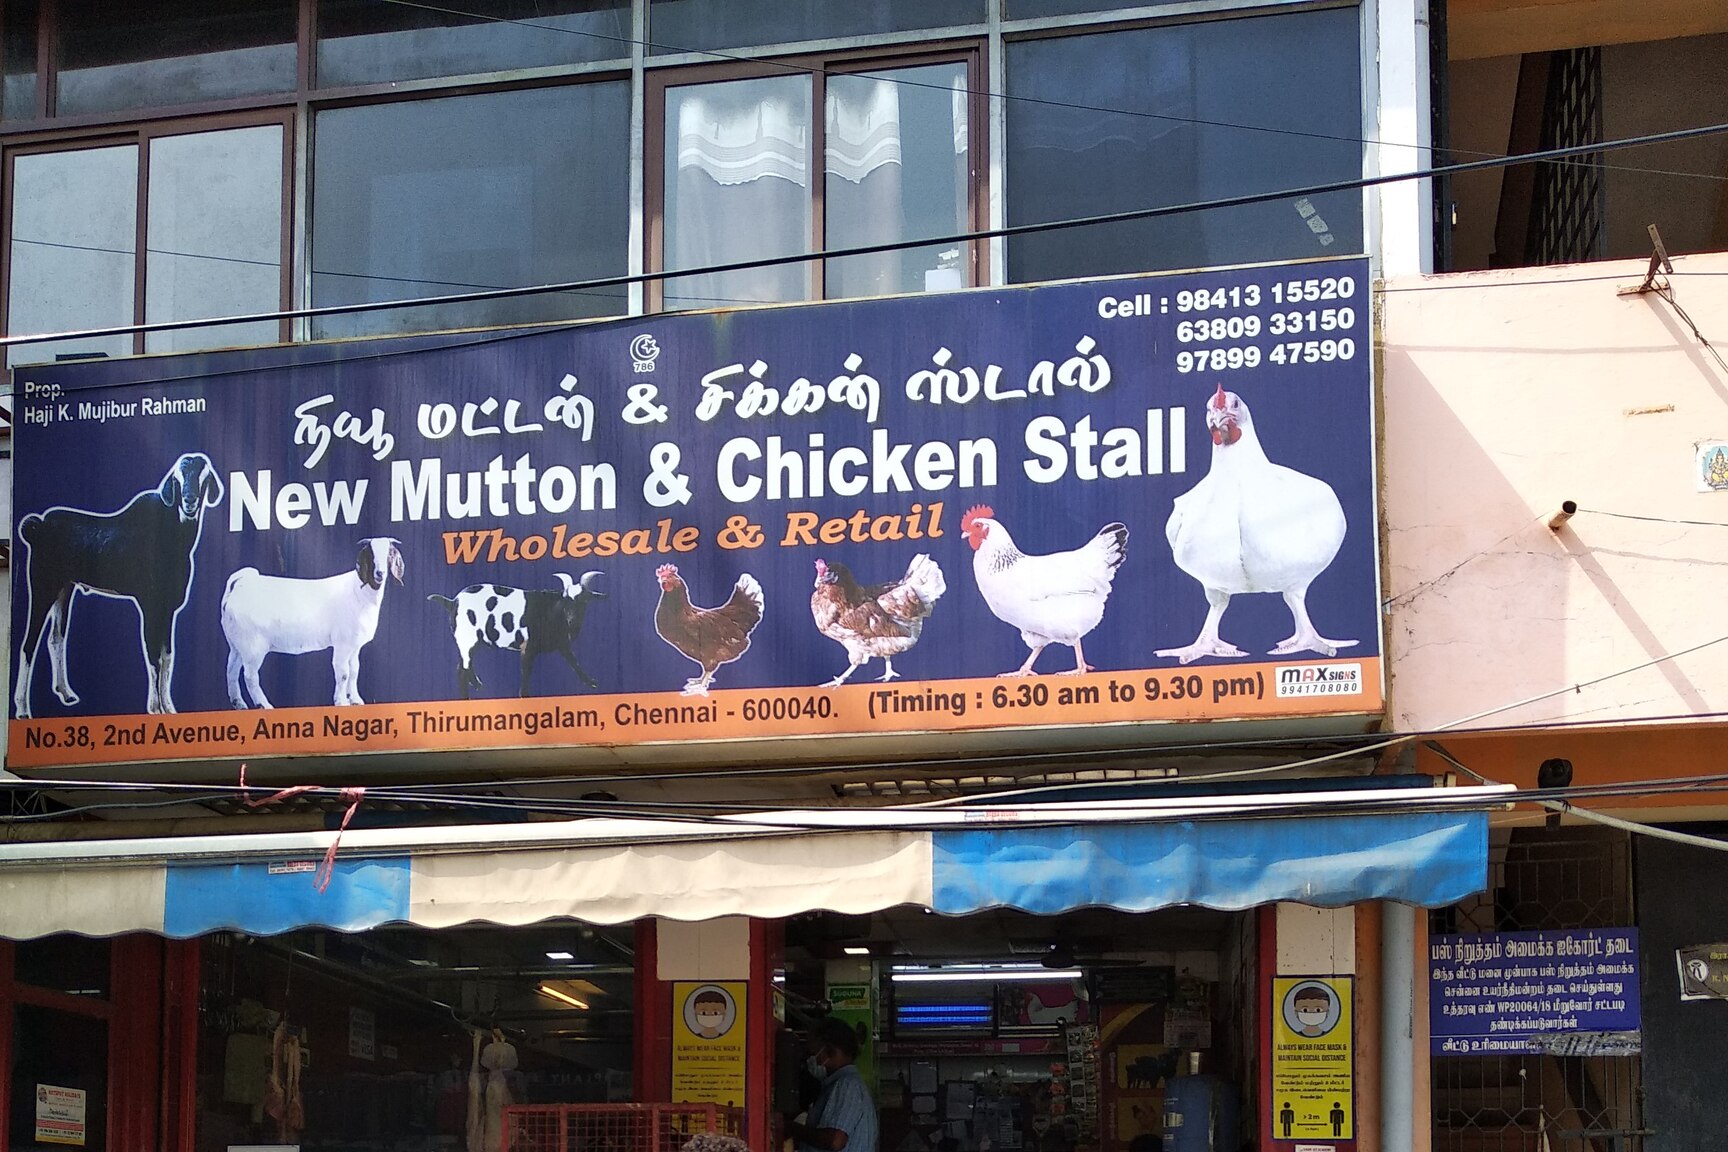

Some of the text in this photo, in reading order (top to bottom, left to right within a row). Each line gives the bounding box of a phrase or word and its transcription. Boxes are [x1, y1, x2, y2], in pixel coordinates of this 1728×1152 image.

[1098, 276, 1355, 318] Cell : 98413 15520
[1176, 307, 1355, 343] 63809 33150
[633, 361, 654, 373] 786
[1176, 338, 1355, 373] 97899 47590
[25, 382, 64, 401] Prop.
[294, 335, 1111, 469] நியூ மட்டன் & சிக்கன் ஸ்டால்
[24, 397, 206, 427] Haji K. Mujibur Rahman
[229, 407, 1187, 532] New Mutton & Chicken Stall
[442, 501, 945, 565] Wholesale & Retail
[1281, 683, 1357, 694] 9941708080
[1329, 671, 1356, 681] SIGNS
[868, 690, 966, 719] (Timing
[992, 683, 1049, 708] 6.30
[1058, 685, 1099, 705] am
[1108, 679, 1135, 703] to
[1145, 675, 1204, 700] 9.30
[1213, 671, 1265, 704] pm)
[25, 725, 95, 753] No.38,
[104, 723, 146, 747] 2nd
[152, 720, 246, 746] Avenue,
[253, 717, 315, 741] Anna
[323, 714, 398, 742] Nagar,
[407, 704, 605, 736] Thirumangalam,
[614, 699, 718, 727] Chennai
[742, 695, 839, 721] 600040.
[1432, 932, 1634, 965] பஸ் நிறுத்தம் அமைக்க ஐகோர்ட் தடை
[1433, 966, 1454, 982] இந்த
[1557, 962, 1595, 979] நிறுத்தம்
[1596, 960, 1635, 976] அமைக்க
[1444, 983, 1480, 997] சென்னை
[1547, 984, 1568, 996] தடை
[1443, 1001, 1476, 1016] உத்தரவு
[1478, 1000, 1495, 1014] எண்
[1497, 998, 1551, 1014] WP20064/18
